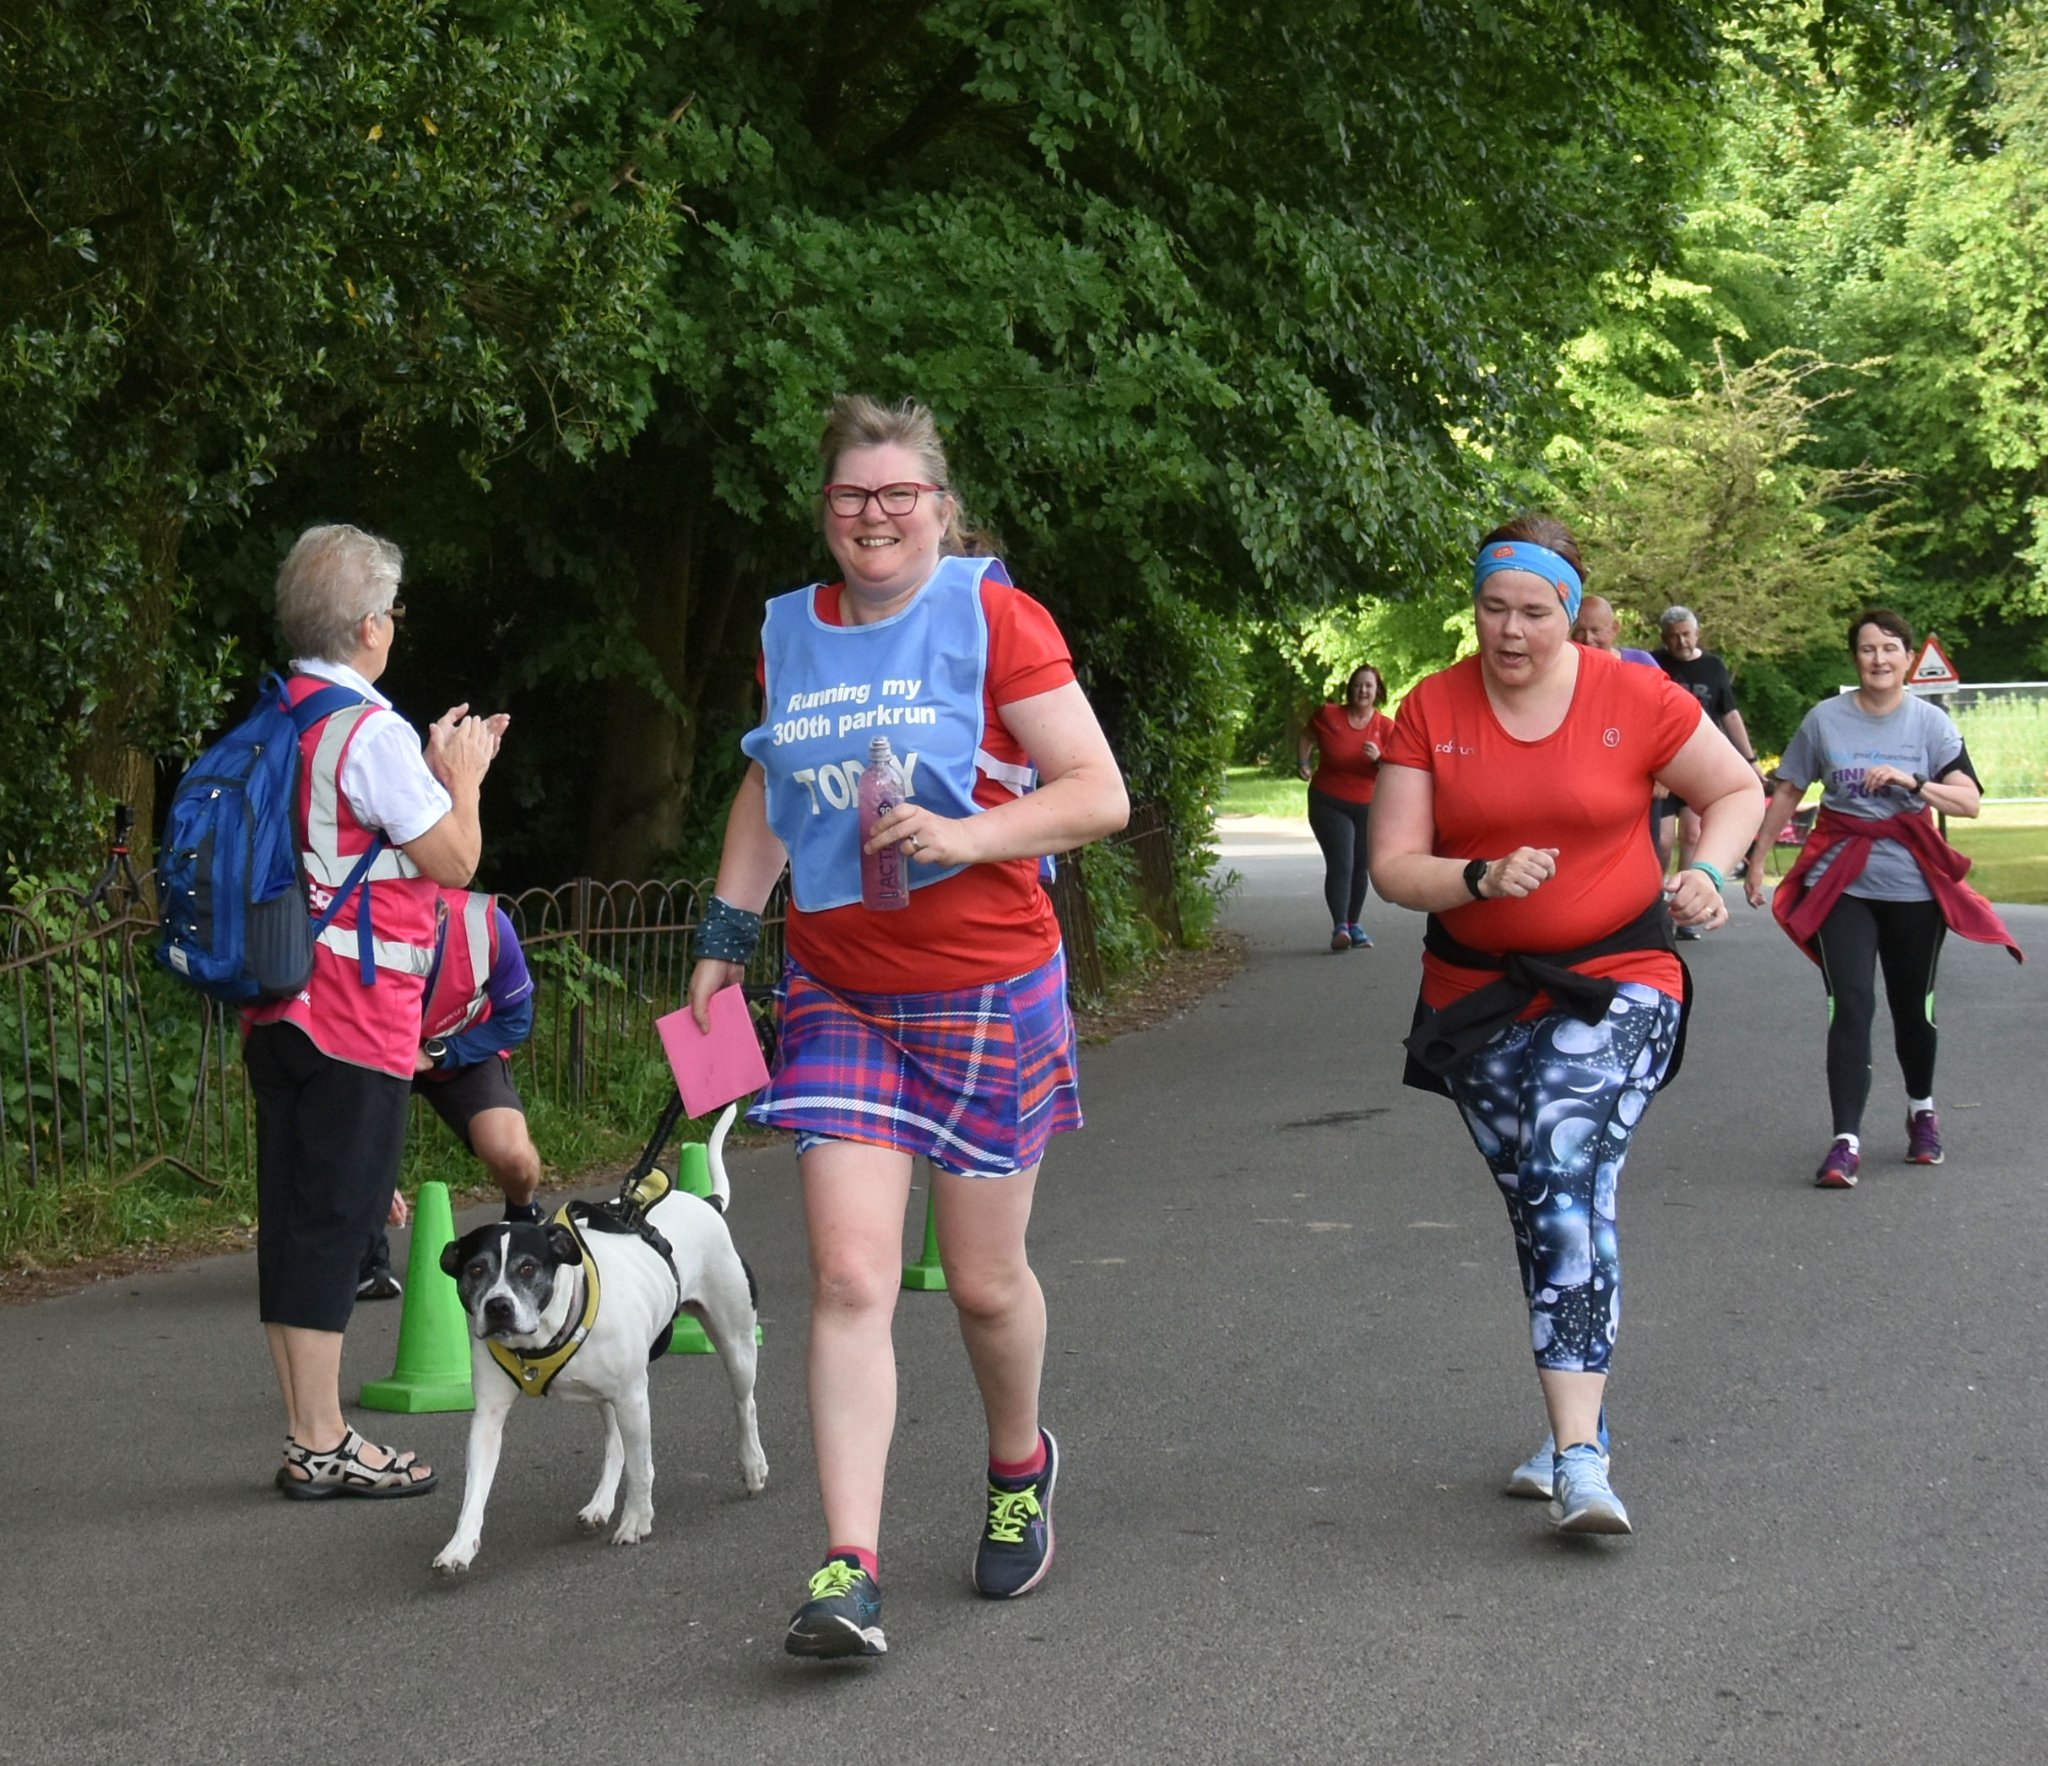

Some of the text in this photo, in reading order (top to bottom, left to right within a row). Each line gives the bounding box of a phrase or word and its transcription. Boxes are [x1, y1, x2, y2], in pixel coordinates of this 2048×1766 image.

[787, 678, 921, 713] Running my
[773, 704, 936, 746] 300th parkrun
[793, 752, 919, 815] TODY
